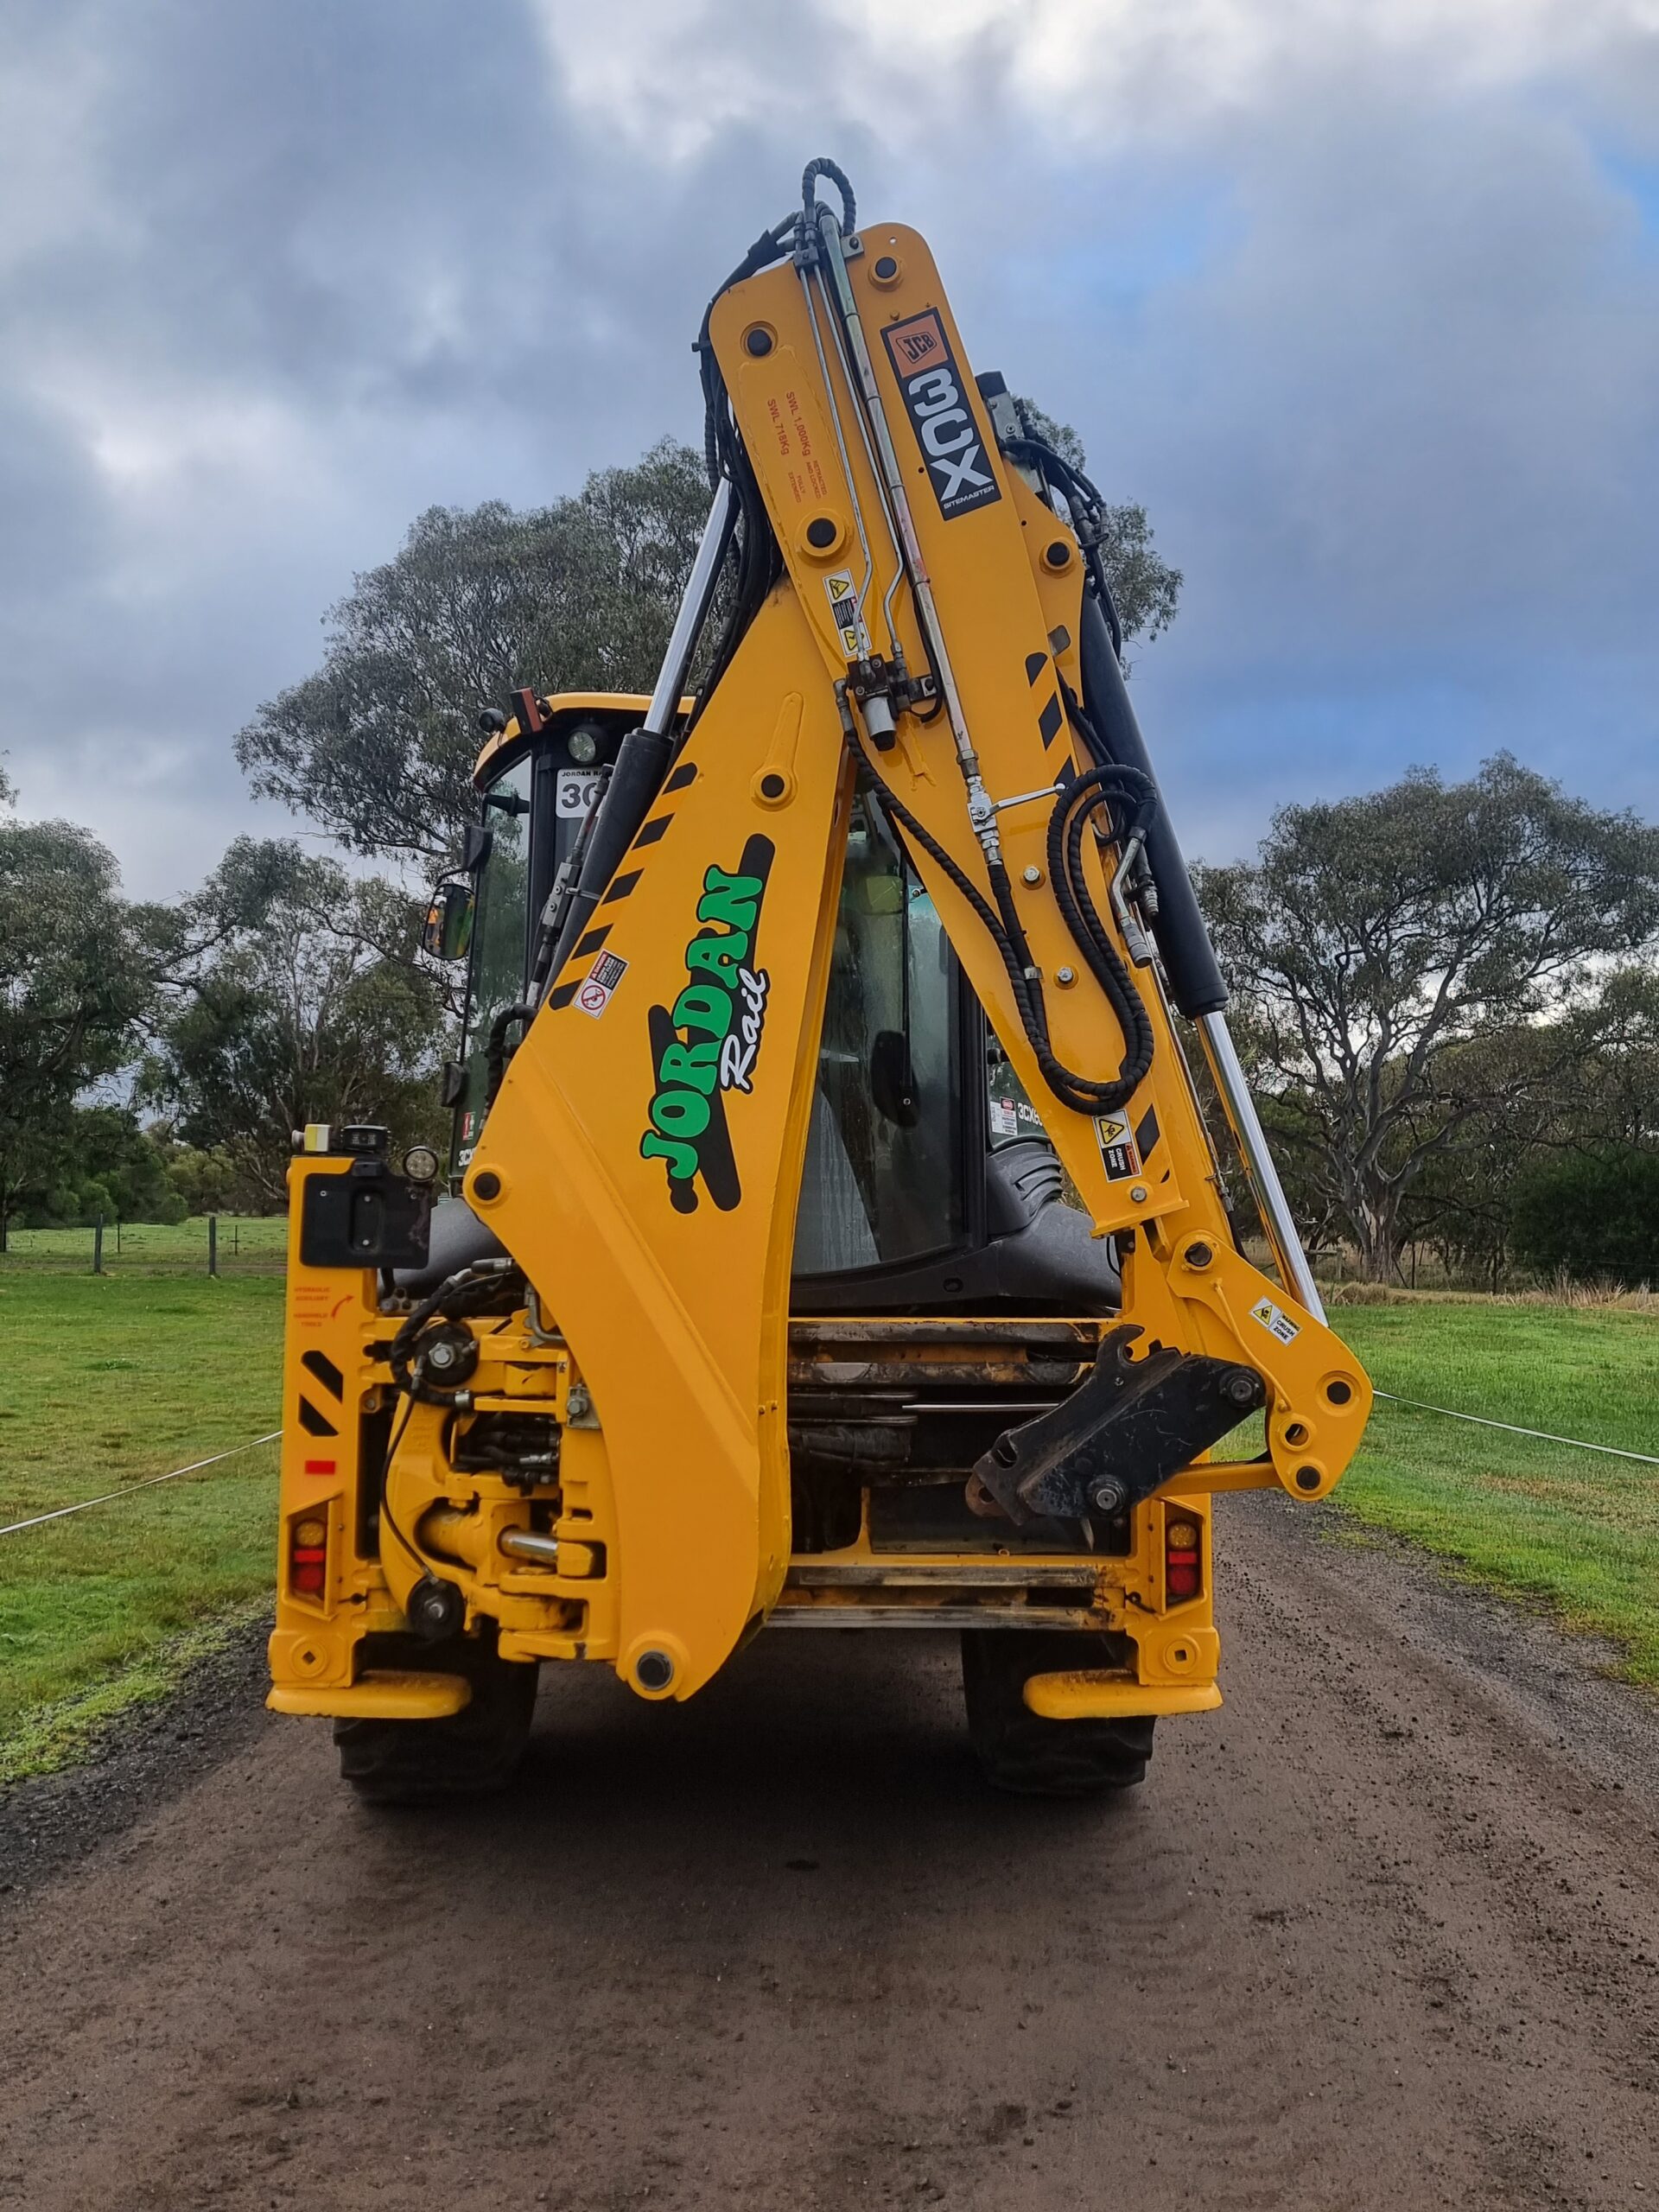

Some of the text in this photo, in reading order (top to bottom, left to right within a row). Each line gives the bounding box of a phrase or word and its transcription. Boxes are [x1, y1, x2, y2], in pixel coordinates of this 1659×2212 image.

[904, 332, 934, 359] JCB
[767, 398, 790, 455] SWL 718Kg
[786, 391, 810, 456] SWL 1,000Kg
[908, 368, 994, 501] 3CX
[944, 485, 995, 509] SITEMASTER
[641, 866, 763, 1179] JORDAN
[721, 968, 766, 1090] Rail
[1108, 1149, 1117, 1167] ZONE
[1116, 1147, 1126, 1171] CRUSH
[1273, 1326, 1288, 1340] ZONE
[1276, 1320, 1294, 1337] CRUSH
